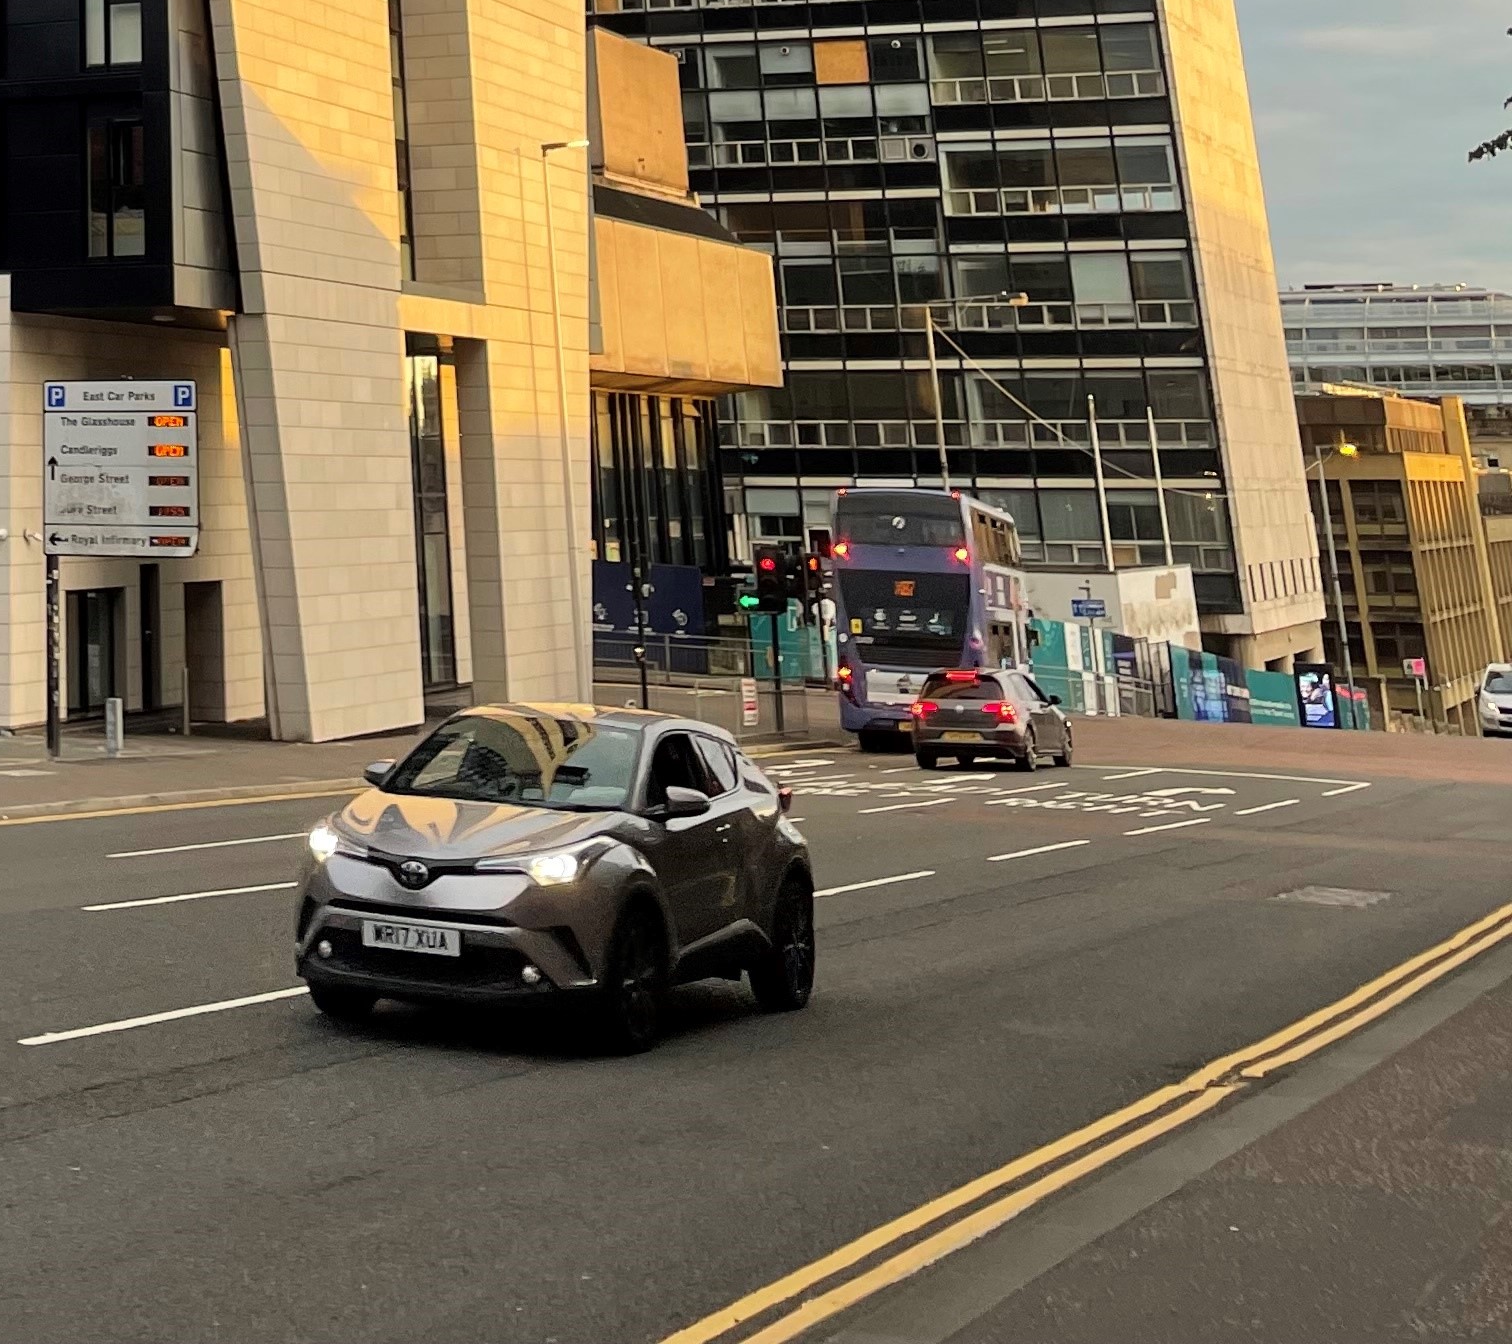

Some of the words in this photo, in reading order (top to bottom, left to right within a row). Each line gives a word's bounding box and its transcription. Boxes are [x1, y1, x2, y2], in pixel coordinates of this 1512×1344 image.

[83, 392, 104, 401] East
[108, 392, 124, 401] Car
[128, 392, 156, 401] Parks
[61, 416, 77, 426] The
[81, 416, 135, 426] Glasshouse
[154, 416, 184, 427] OPEN
[60, 445, 118, 456] Candleriggs
[155, 446, 184, 457] OPEN
[60, 473, 94, 484] George
[98, 473, 130, 483] Street
[87, 505, 117, 515] Street
[71, 534, 98, 546] Royal
[102, 535, 147, 547] Infirmary
[1054, 791, 1227, 812] TURN
